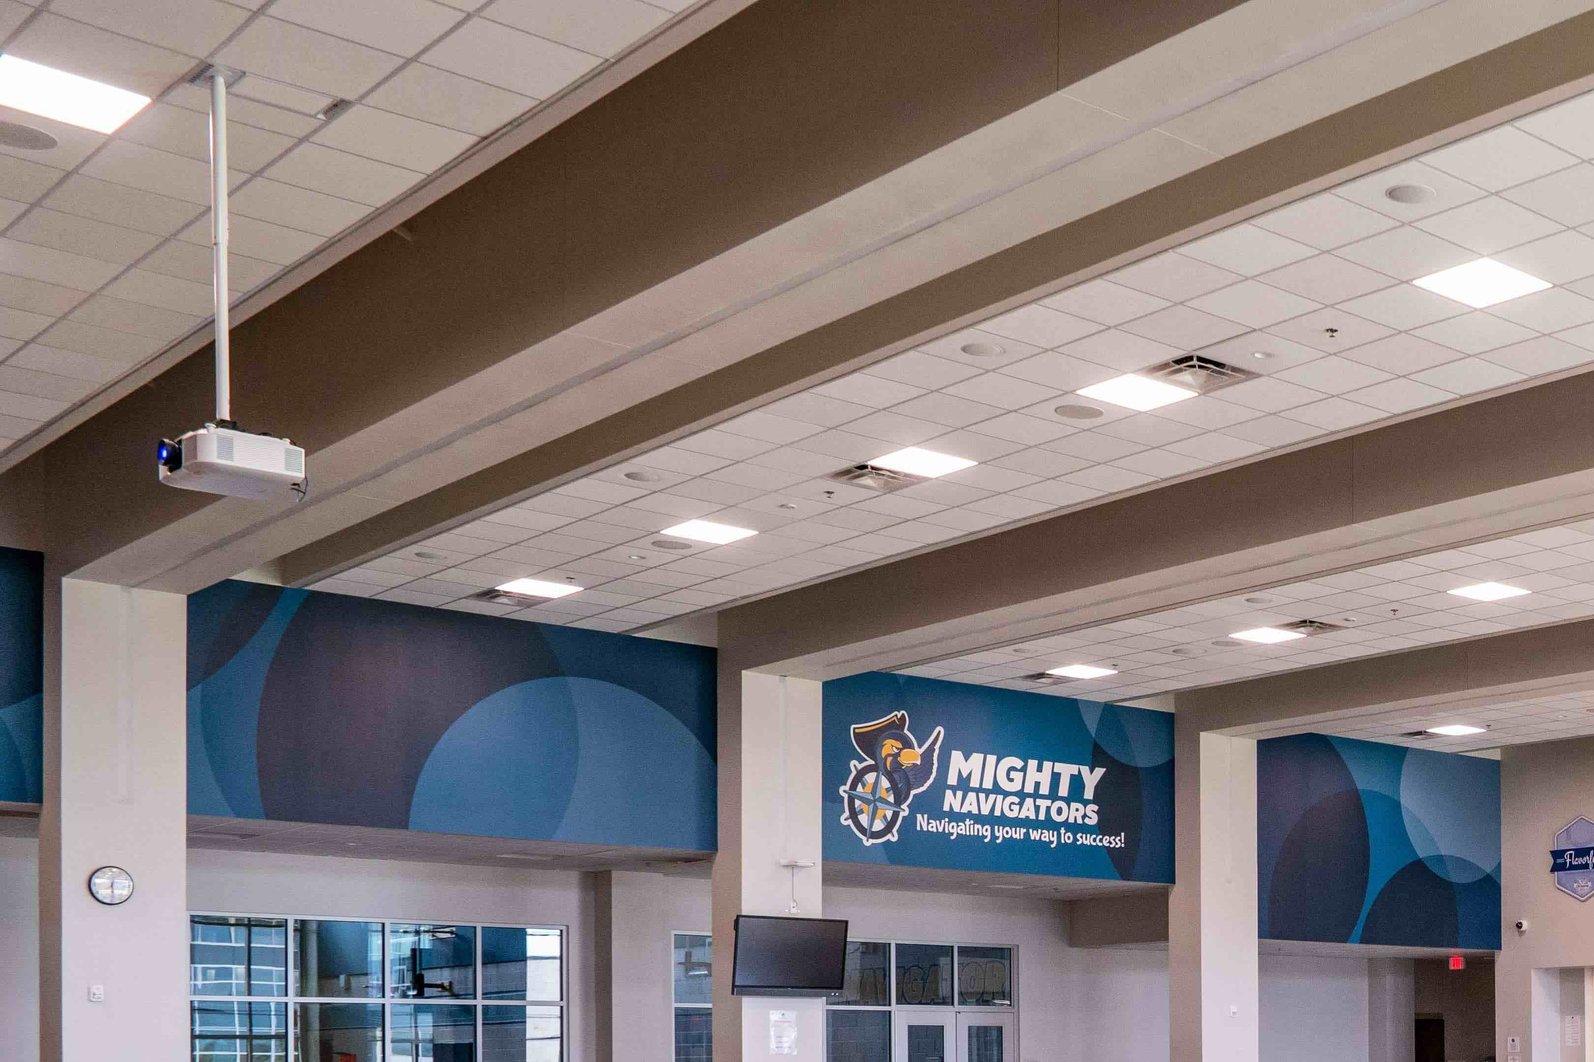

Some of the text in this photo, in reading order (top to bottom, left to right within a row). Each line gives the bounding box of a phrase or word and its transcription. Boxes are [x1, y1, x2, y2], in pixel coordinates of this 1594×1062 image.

[946, 750, 1106, 800] MIGHTY
[943, 790, 1099, 825] NAVIGATORS
[916, 814, 1125, 849] Navigating your way to success!
